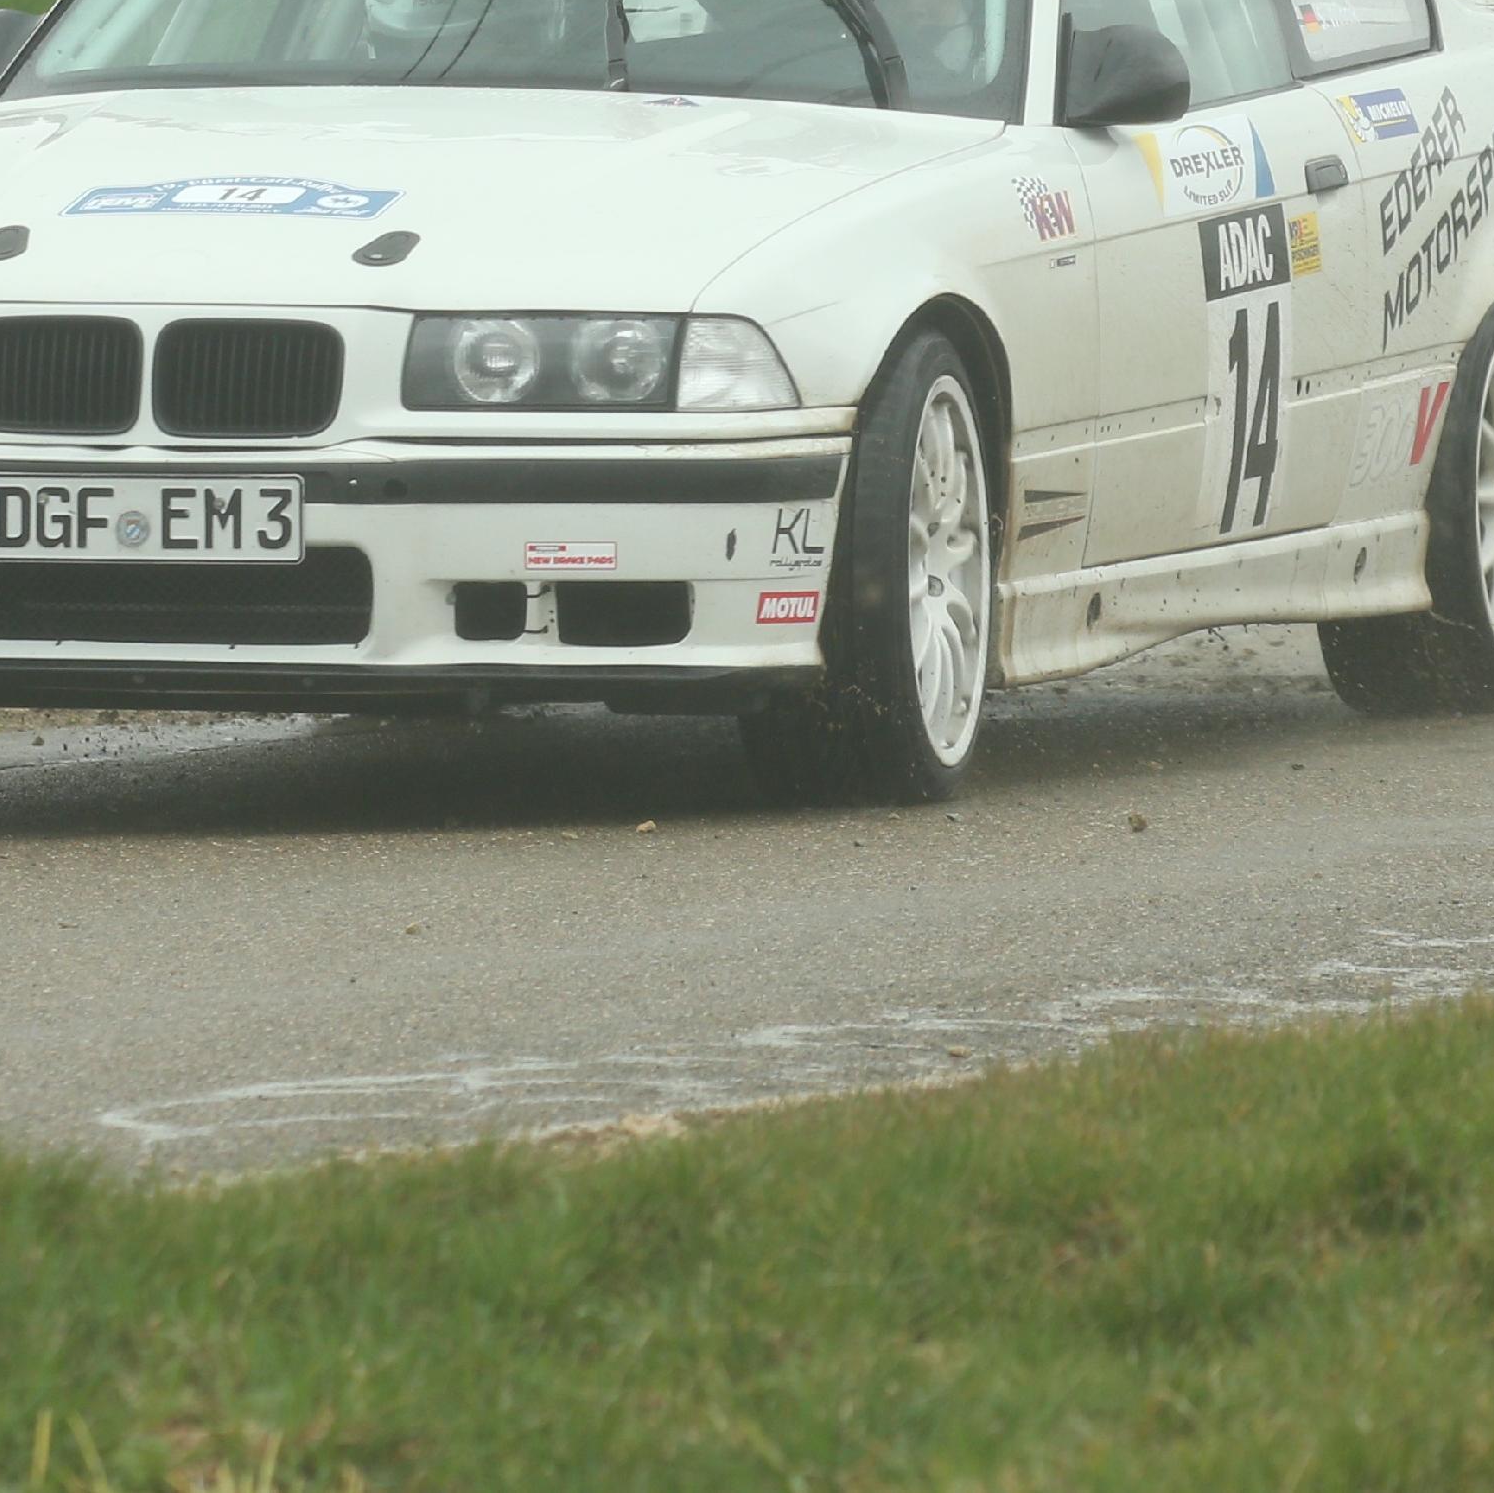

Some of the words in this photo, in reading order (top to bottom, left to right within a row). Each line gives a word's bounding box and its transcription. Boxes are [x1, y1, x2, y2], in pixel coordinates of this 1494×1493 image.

[1367, 100, 1411, 122] MICHELIN
[1169, 146, 1245, 178] DREXLER
[1380, 85, 1466, 256] EDERER
[218, 187, 267, 202] 14
[1183, 185, 1218, 205] LIMITED
[1219, 179, 1234, 202] SLIP
[1028, 190, 1076, 242] KW
[1217, 214, 1274, 292] ADAC
[1219, 302, 1281, 535] 14
[162, 488, 242, 549] EM
[772, 508, 825, 554] KL
[553, 556, 585, 564] BRAKE
[759, 596, 815, 619] MOTUL
